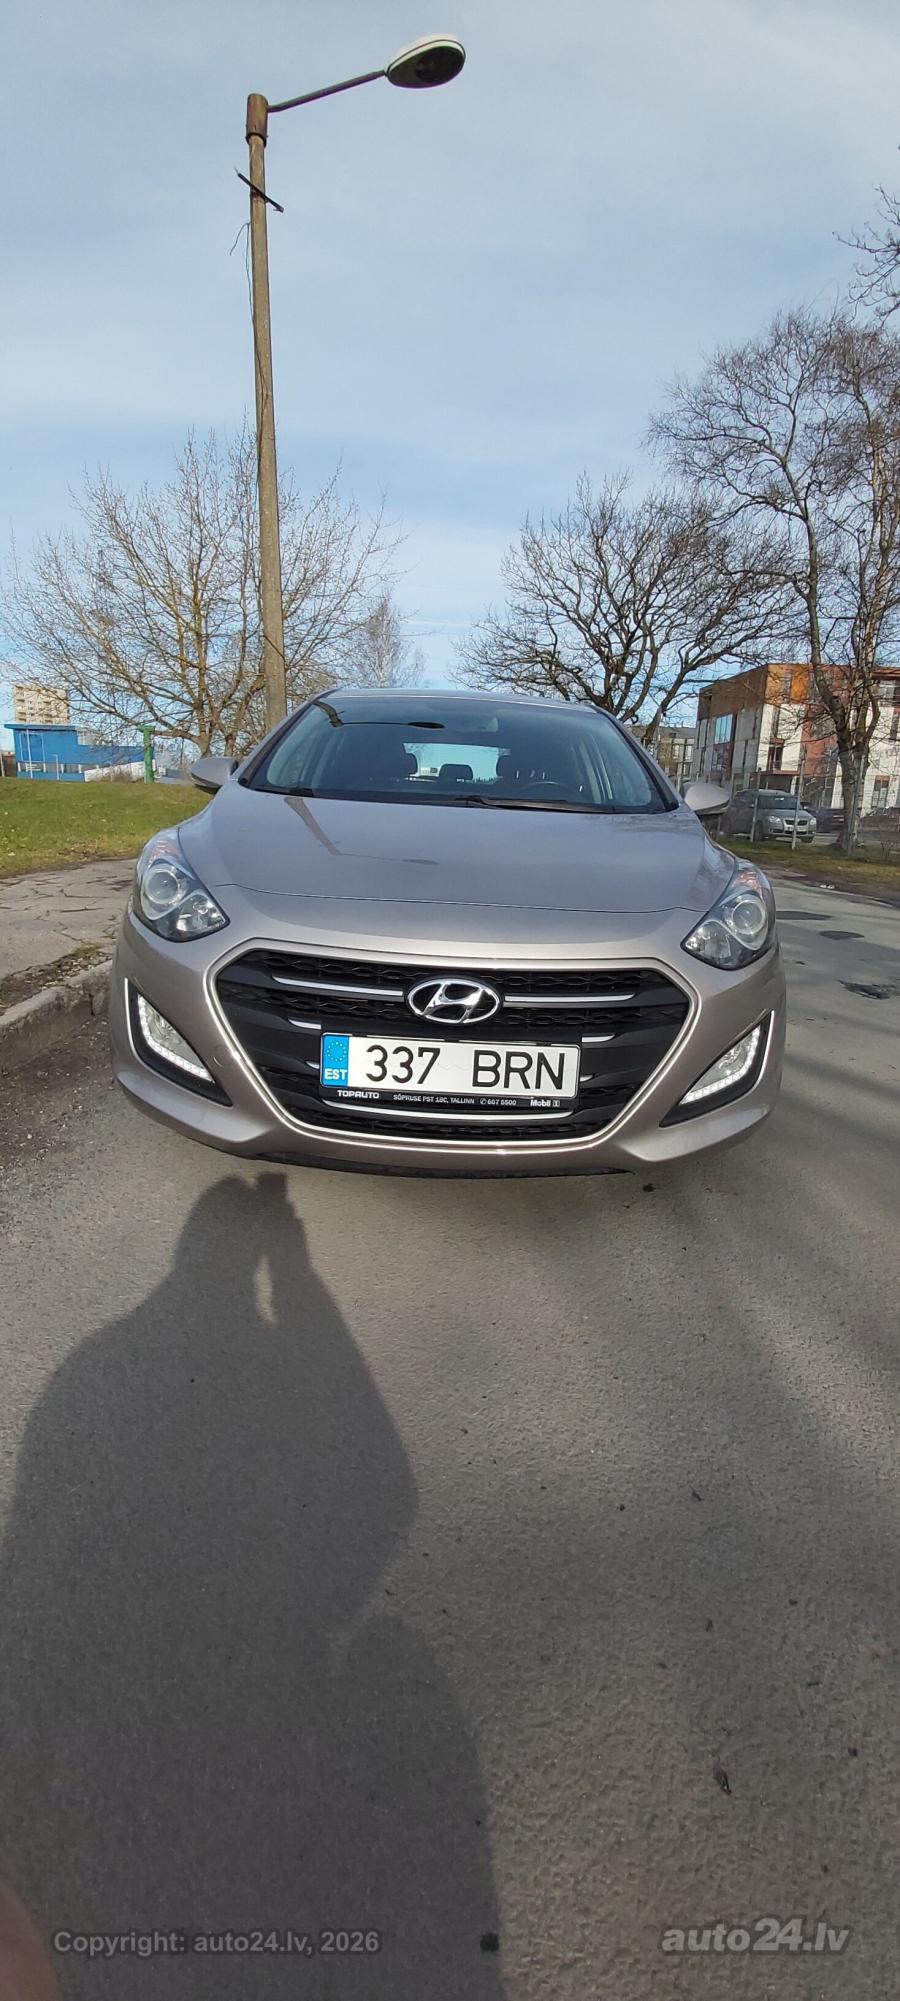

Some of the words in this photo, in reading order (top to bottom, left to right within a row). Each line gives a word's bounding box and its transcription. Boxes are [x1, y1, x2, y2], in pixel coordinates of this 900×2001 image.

[366, 1045, 440, 1085] 337
[472, 1050, 565, 1090] BRN
[324, 1068, 347, 1081] EST
[337, 1089, 380, 1099] TOPAUTO
[530, 1099, 551, 1107] Mobil
